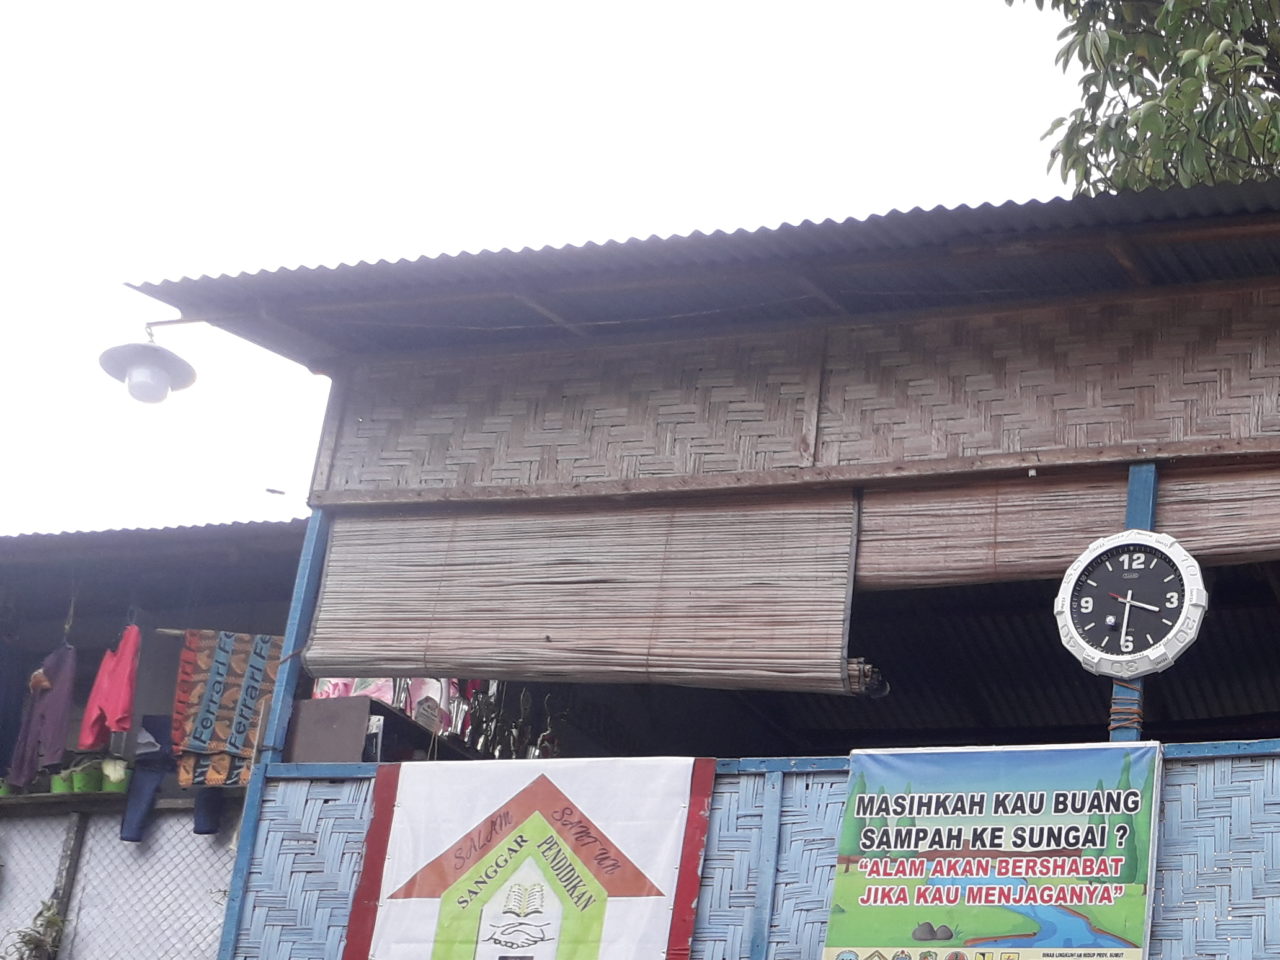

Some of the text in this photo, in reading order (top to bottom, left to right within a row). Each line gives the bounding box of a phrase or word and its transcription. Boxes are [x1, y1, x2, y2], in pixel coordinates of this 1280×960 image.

[1119, 553, 1145, 570] 12
[1080, 597, 1093, 613] 9
[1165, 592, 1179, 608] 3
[1121, 635, 1134, 652] 6
[856, 790, 1140, 816] MASIHKAH KAU BUANG
[454, 810, 513, 870] SALAM
[861, 825, 1128, 850] SAMPAH KE SUNGAI ?
[457, 834, 596, 912] SANGGAR PENDIDIKAN
[931, 859, 990, 877] AKAN
[996, 858, 1123, 877] BERSHABAT
[860, 887, 908, 904] JIKA
[915, 886, 960, 904] KAU
